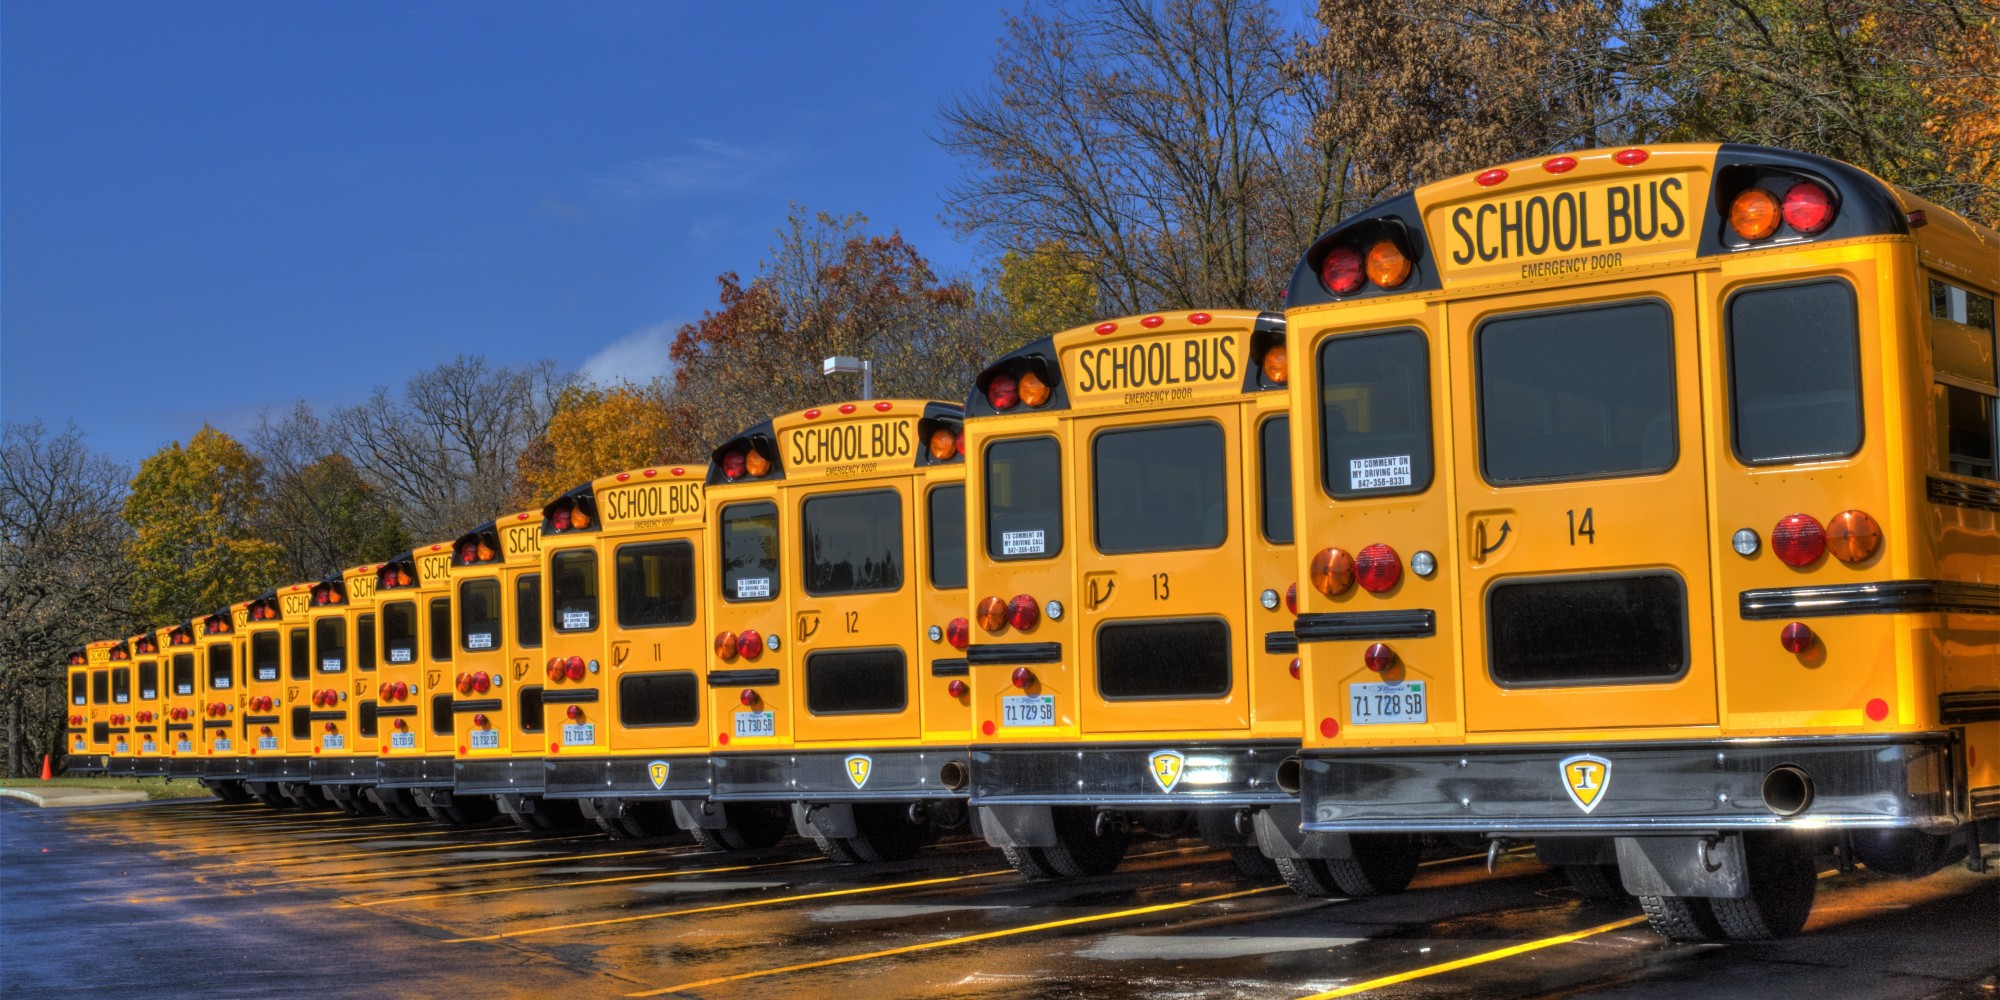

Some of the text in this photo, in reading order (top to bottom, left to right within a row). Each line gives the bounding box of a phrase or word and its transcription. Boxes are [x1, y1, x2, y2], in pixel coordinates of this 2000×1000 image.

[1452, 177, 1686, 266] SCHOOL BUS
[1521, 252, 1622, 280] EMERGENCY DOOR
[1079, 335, 1236, 392] SCHOOL BUS
[1124, 387, 1192, 405] EMERGENCY DOOR
[792, 420, 910, 466] SCHOOL BUS
[826, 462, 878, 477] EMERGENCY DOOR
[1352, 466, 1410, 478] MY DRIVING CALL
[1353, 456, 1408, 468] TO COMMENT ON
[1358, 476, 1405, 488] 847-356-8331
[608, 482, 700, 520] SCHOOL BUS
[1566, 507, 1595, 546] 14
[1152, 572, 1169, 601] 13
[845, 611, 859, 633] 12
[654, 643, 661, 662] 11
[1005, 704, 1052, 720] 71 729 SB
[1354, 694, 1422, 716] 71 728 SB
[737, 719, 772, 732] 71 730 SB
[565, 730, 572, 742] 71
[586, 730, 592, 740] SB
